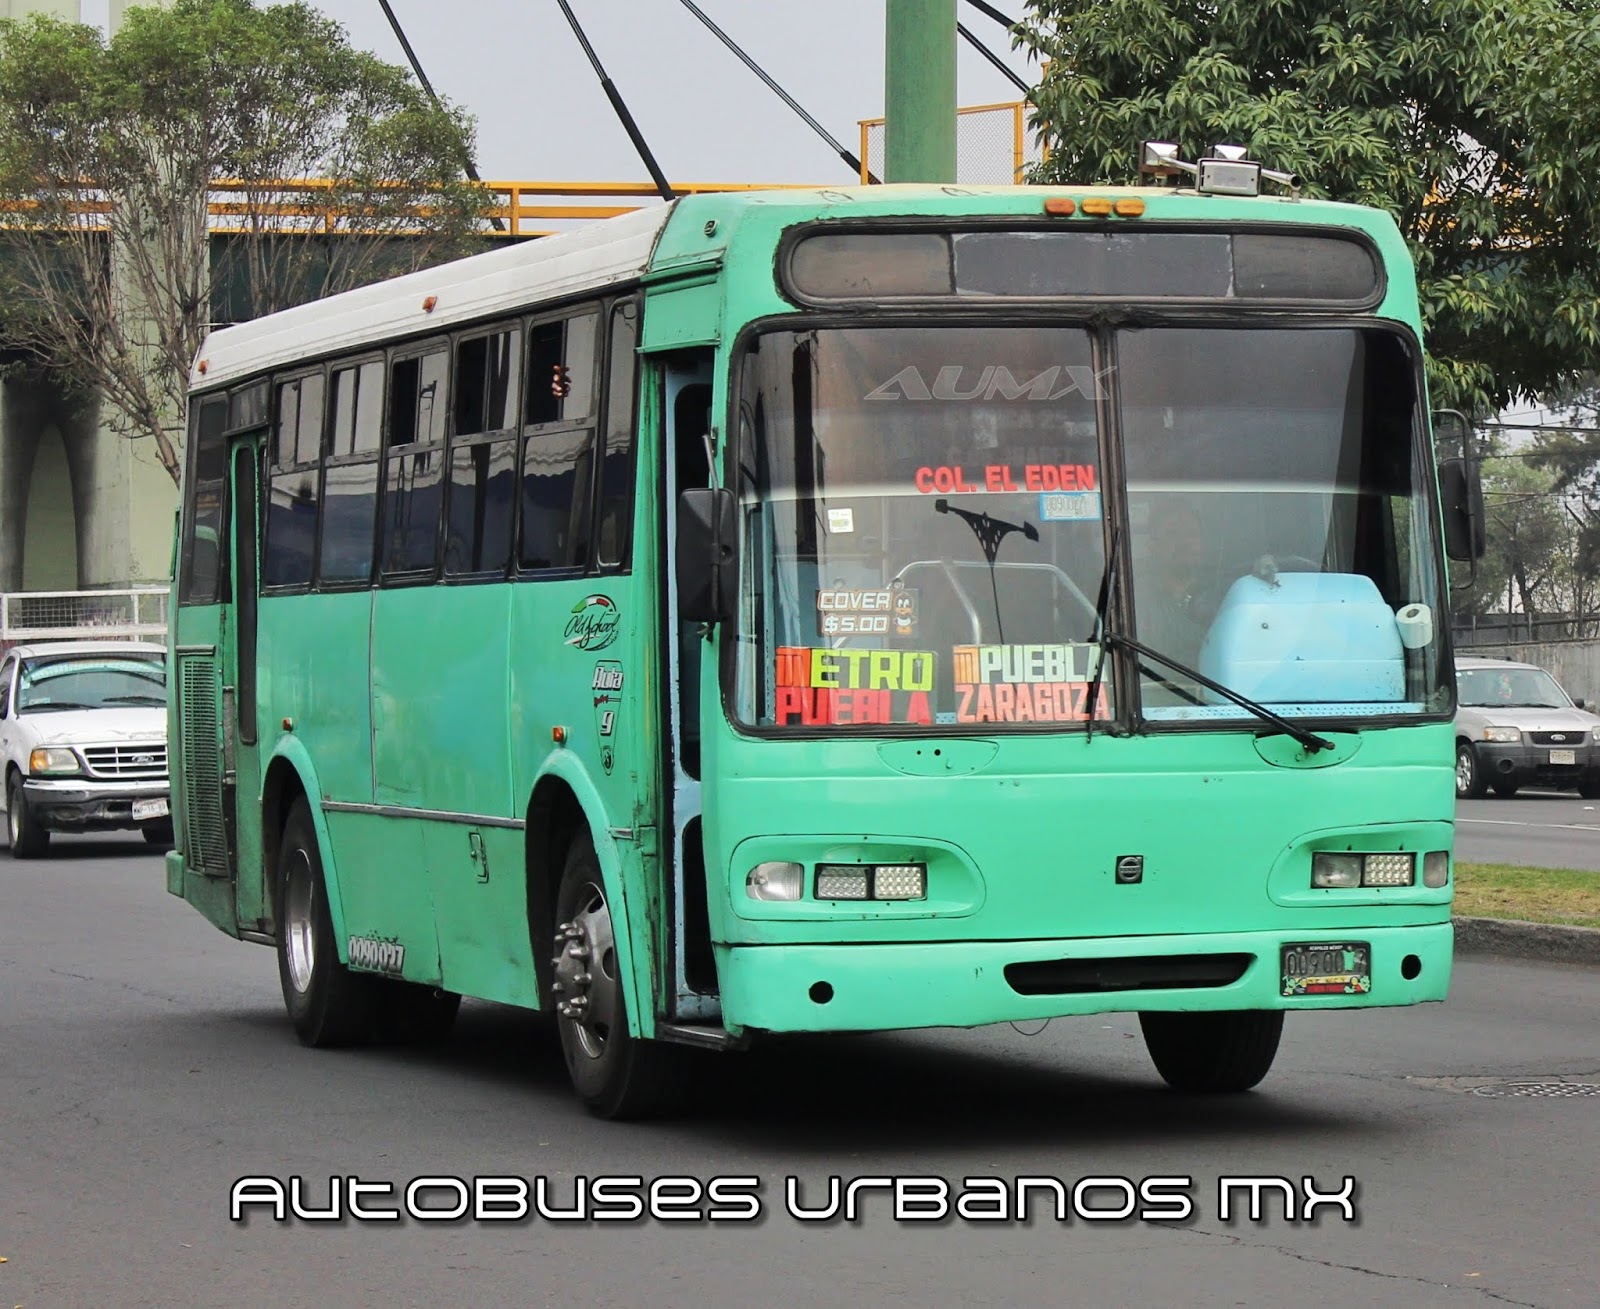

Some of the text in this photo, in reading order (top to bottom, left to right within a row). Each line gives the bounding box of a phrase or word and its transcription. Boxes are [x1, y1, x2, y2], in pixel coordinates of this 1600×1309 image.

[915, 464, 1094, 493] COL. EL EDEN
[818, 591, 892, 610] COVER
[823, 615, 889, 634] $5.00
[955, 682, 1111, 723] ZARAGOZA
[600, 710, 615, 736] 9
